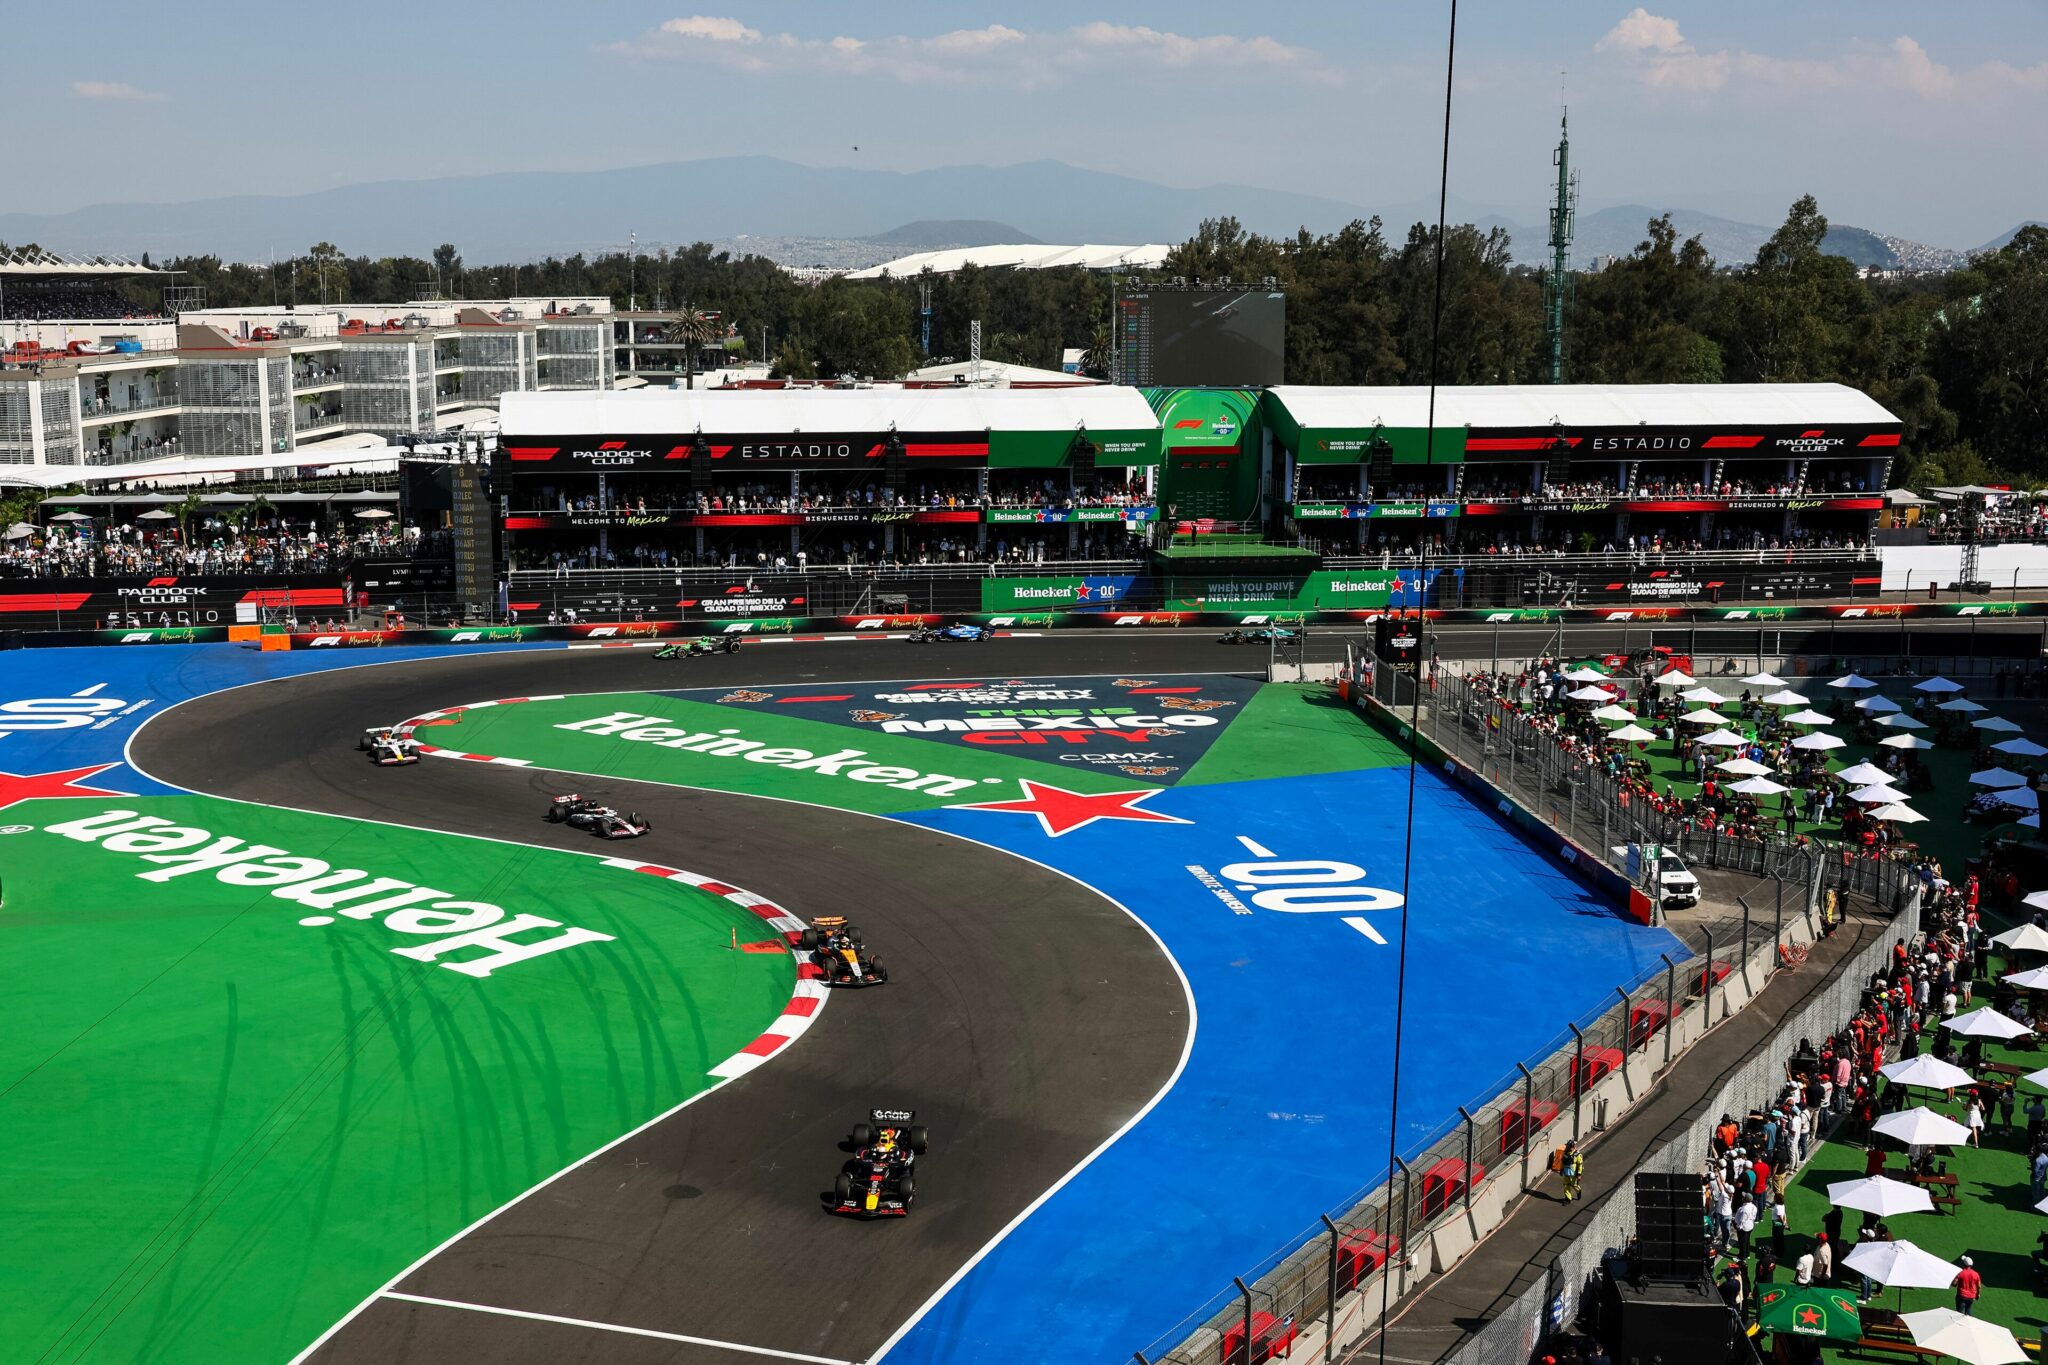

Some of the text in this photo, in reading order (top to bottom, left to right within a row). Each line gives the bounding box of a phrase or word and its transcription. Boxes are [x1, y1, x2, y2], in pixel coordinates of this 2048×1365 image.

[1593, 437, 1691, 449] ESTADIO
[1776, 438, 1845, 446] PADDOCK
[573, 450, 652, 458] PADDOCK
[742, 445, 850, 458] ESTADIO
[591, 457, 635, 465] CLUB
[462, 492, 472, 500] LEC
[1572, 502, 1610, 513] Mexico
[1787, 500, 1825, 510] Mexico
[1078, 510, 1116, 519] Heineken
[1301, 507, 1338, 516] Heineken
[1382, 506, 1418, 515] Heineken
[627, 515, 670, 526] Mexico
[994, 512, 1032, 520] Heineken
[463, 528, 474, 536] VER
[464, 563, 475, 571] TSU
[464, 575, 474, 583] PIA
[1208, 581, 1295, 593] WHEN YOU DRIVE
[1331, 580, 1386, 592] Heineken
[117, 587, 207, 596] PADDOCK
[1014, 586, 1072, 598] Heineken
[139, 595, 187, 604] CLUB
[727, 598, 761, 606] PREMIO
[1208, 592, 1275, 603] NEVER DRINK
[704, 605, 736, 613] CIUDAD
[1872, 607, 1890, 617] Mexico
[1988, 606, 2006, 614] Mexico
[1149, 614, 1169, 623] Mexico
[1274, 614, 1293, 623] Mexico
[1519, 612, 1537, 621] Mexico
[1638, 611, 1657, 620] Mexico
[1756, 610, 1774, 619] Mexico
[891, 617, 911, 627] Mexico
[1022, 616, 1041, 625] Mexico
[625, 626, 645, 635] Mexico
[760, 622, 780, 631] Mexico
[160, 631, 181, 642] Mexico
[489, 630, 510, 640] Mexico
[349, 635, 369, 645] Mexico
[965, 708, 1137, 717] THIS IS
[881, 715, 1219, 734] MEXICO
[961, 729, 1153, 745] CITY
[552, 711, 979, 797] Heineken
[43, 809, 617, 978] Heineken
[1793, 1325, 1827, 1336] Heineken
